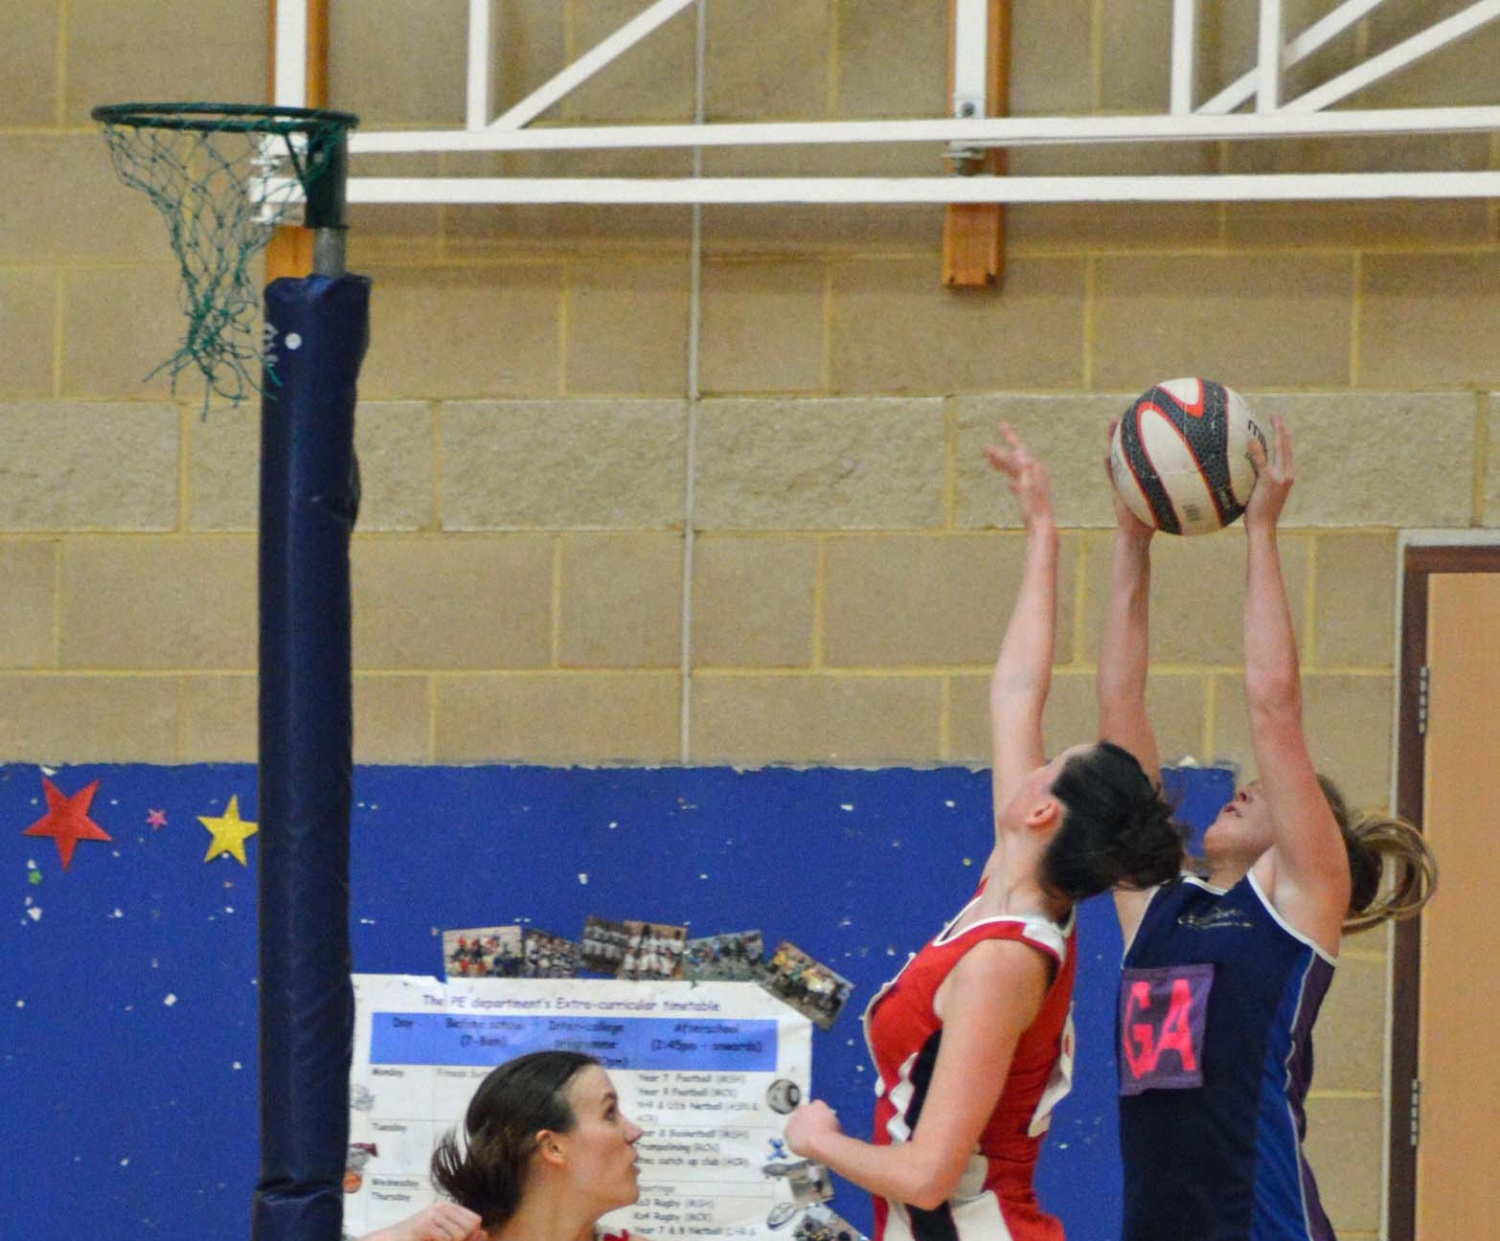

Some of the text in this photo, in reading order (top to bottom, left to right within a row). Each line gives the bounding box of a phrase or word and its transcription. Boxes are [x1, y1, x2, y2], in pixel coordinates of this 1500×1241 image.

[423, 994, 720, 1012] The PE department's Extra-curricular timetable
[1123, 979, 1197, 1080] GA
